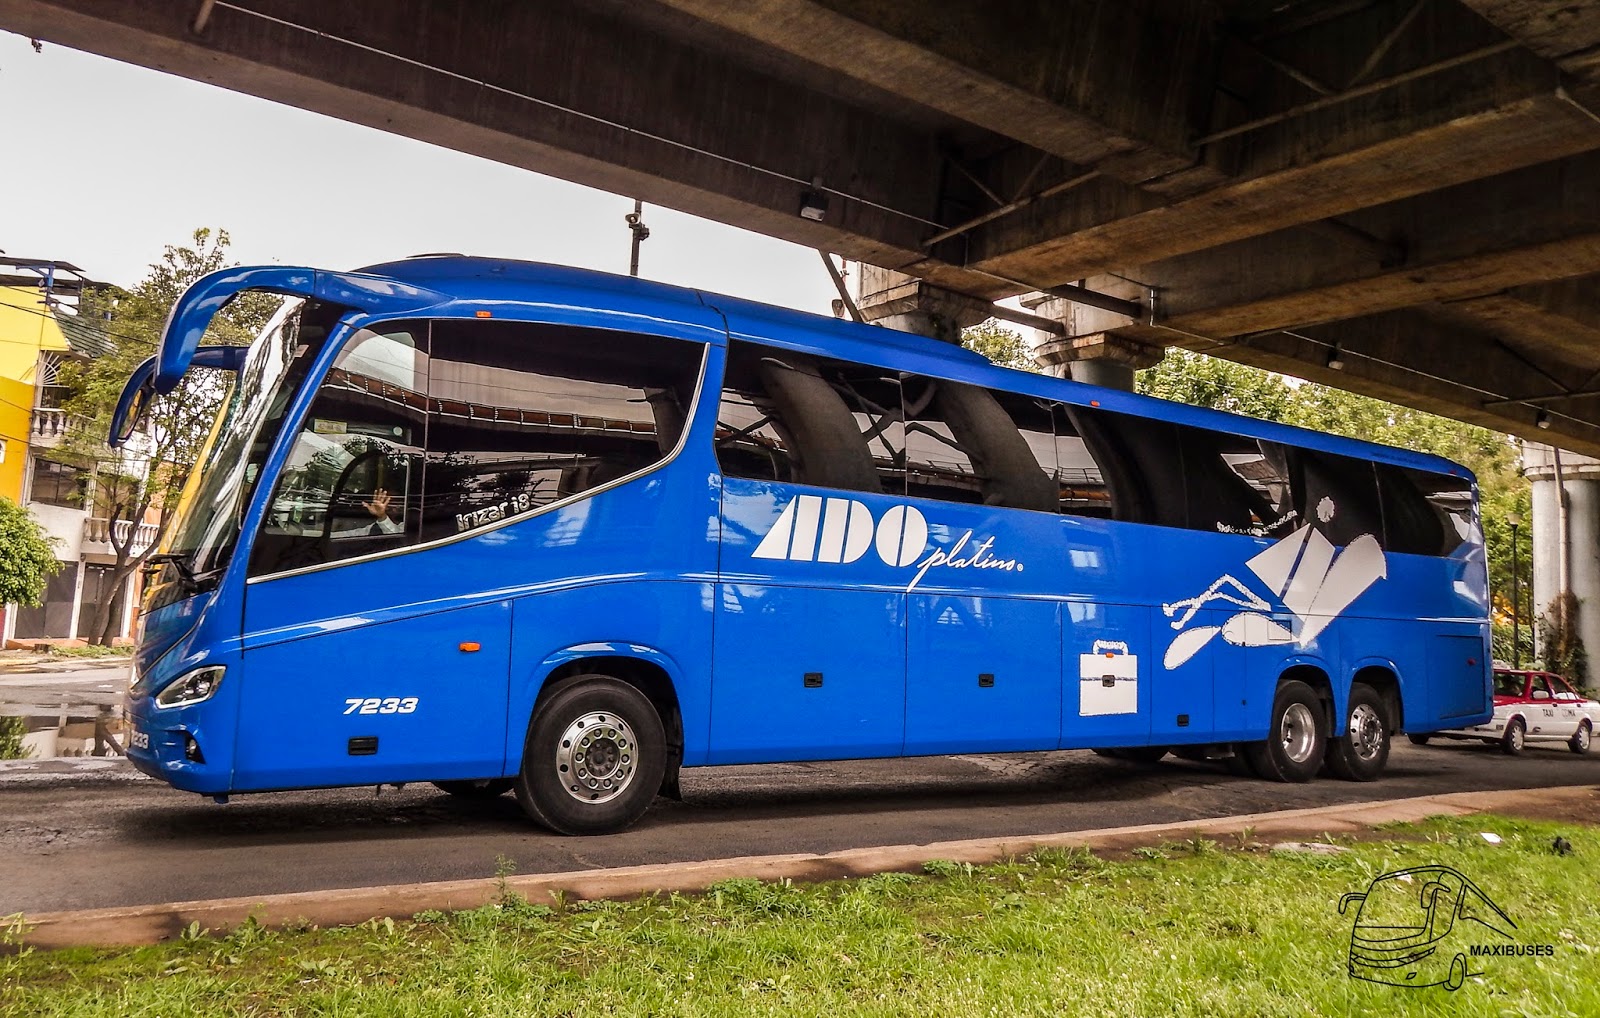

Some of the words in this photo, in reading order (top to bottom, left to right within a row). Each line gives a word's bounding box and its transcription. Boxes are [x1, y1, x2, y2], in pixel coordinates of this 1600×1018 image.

[510, 493, 531, 514] i8
[751, 494, 928, 568] ADO
[917, 529, 1016, 593] platino
[343, 697, 419, 715] 7233
[1542, 708, 1554, 718] TAXI
